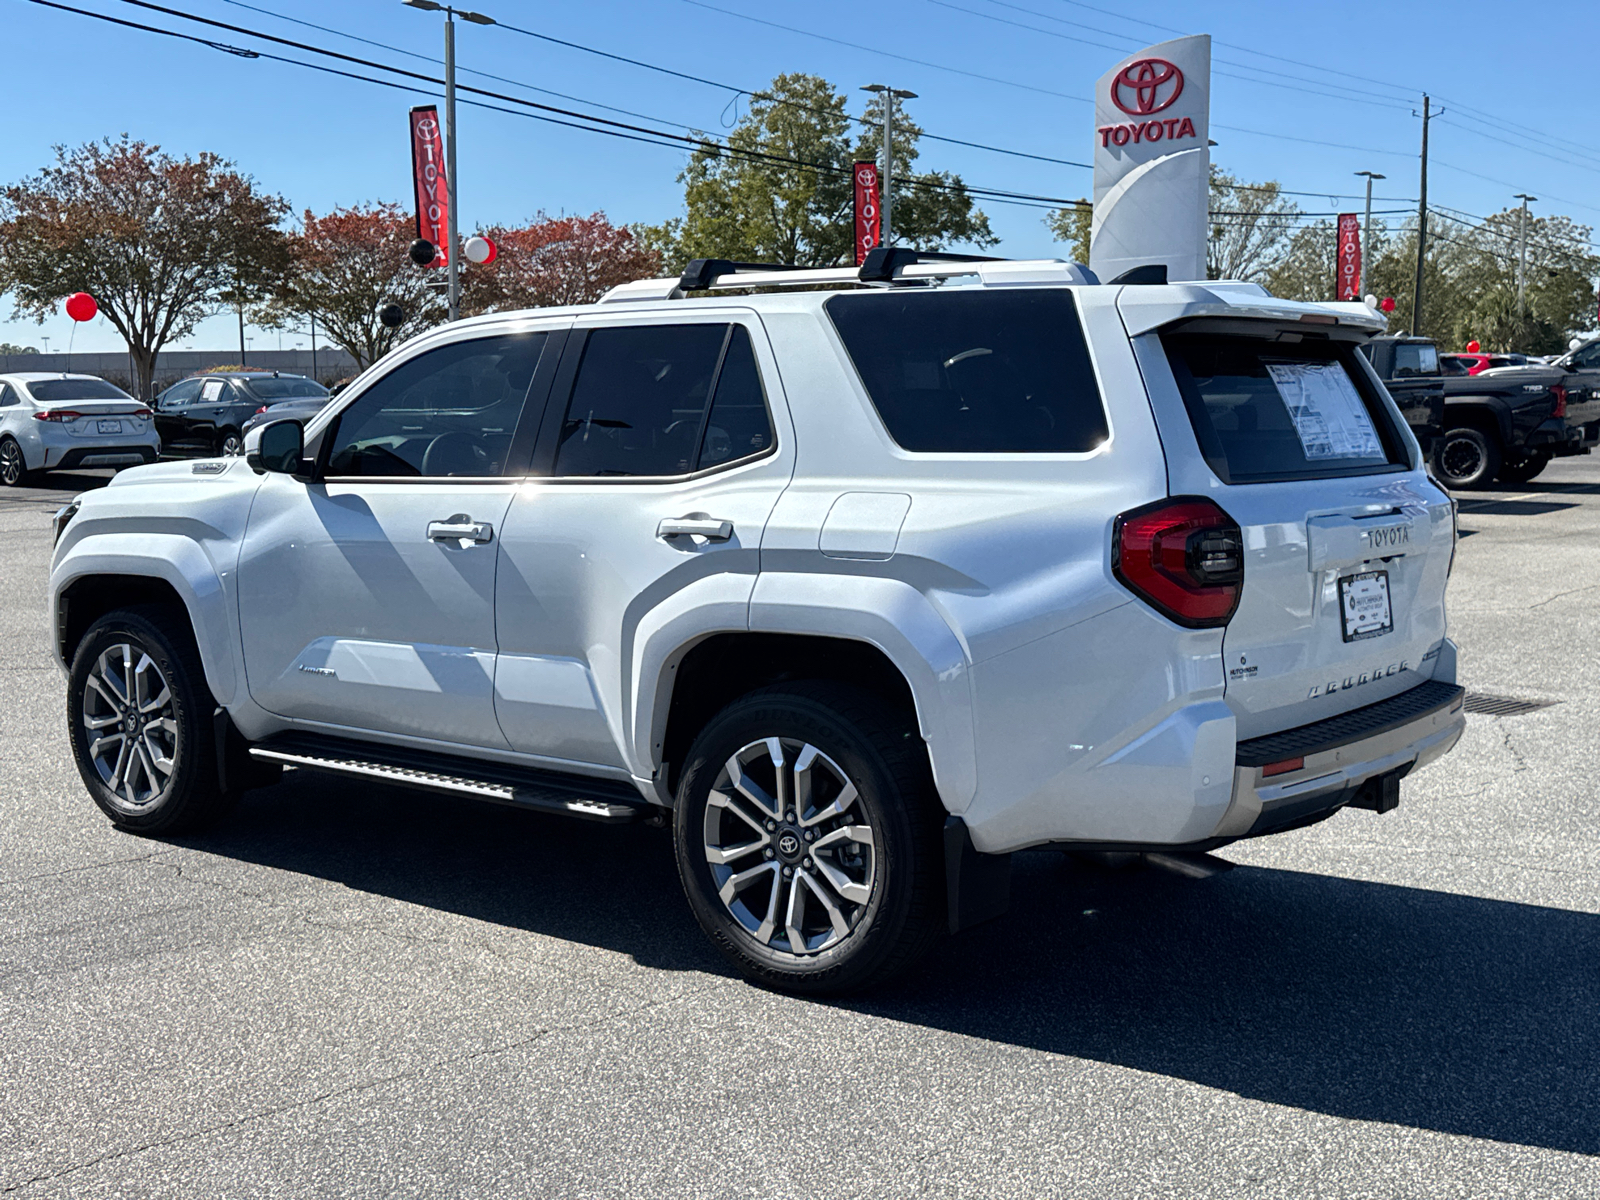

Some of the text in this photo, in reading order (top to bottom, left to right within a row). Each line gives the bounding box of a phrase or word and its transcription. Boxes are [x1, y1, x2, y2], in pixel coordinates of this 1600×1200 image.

[1098, 117, 1196, 148] TOYOTA
[424, 144, 447, 260] TOYOTA
[1344, 232, 1356, 297] TOYOTA
[1367, 526, 1409, 549] TOYOTA
[1308, 660, 1409, 699] 4RUNNER
